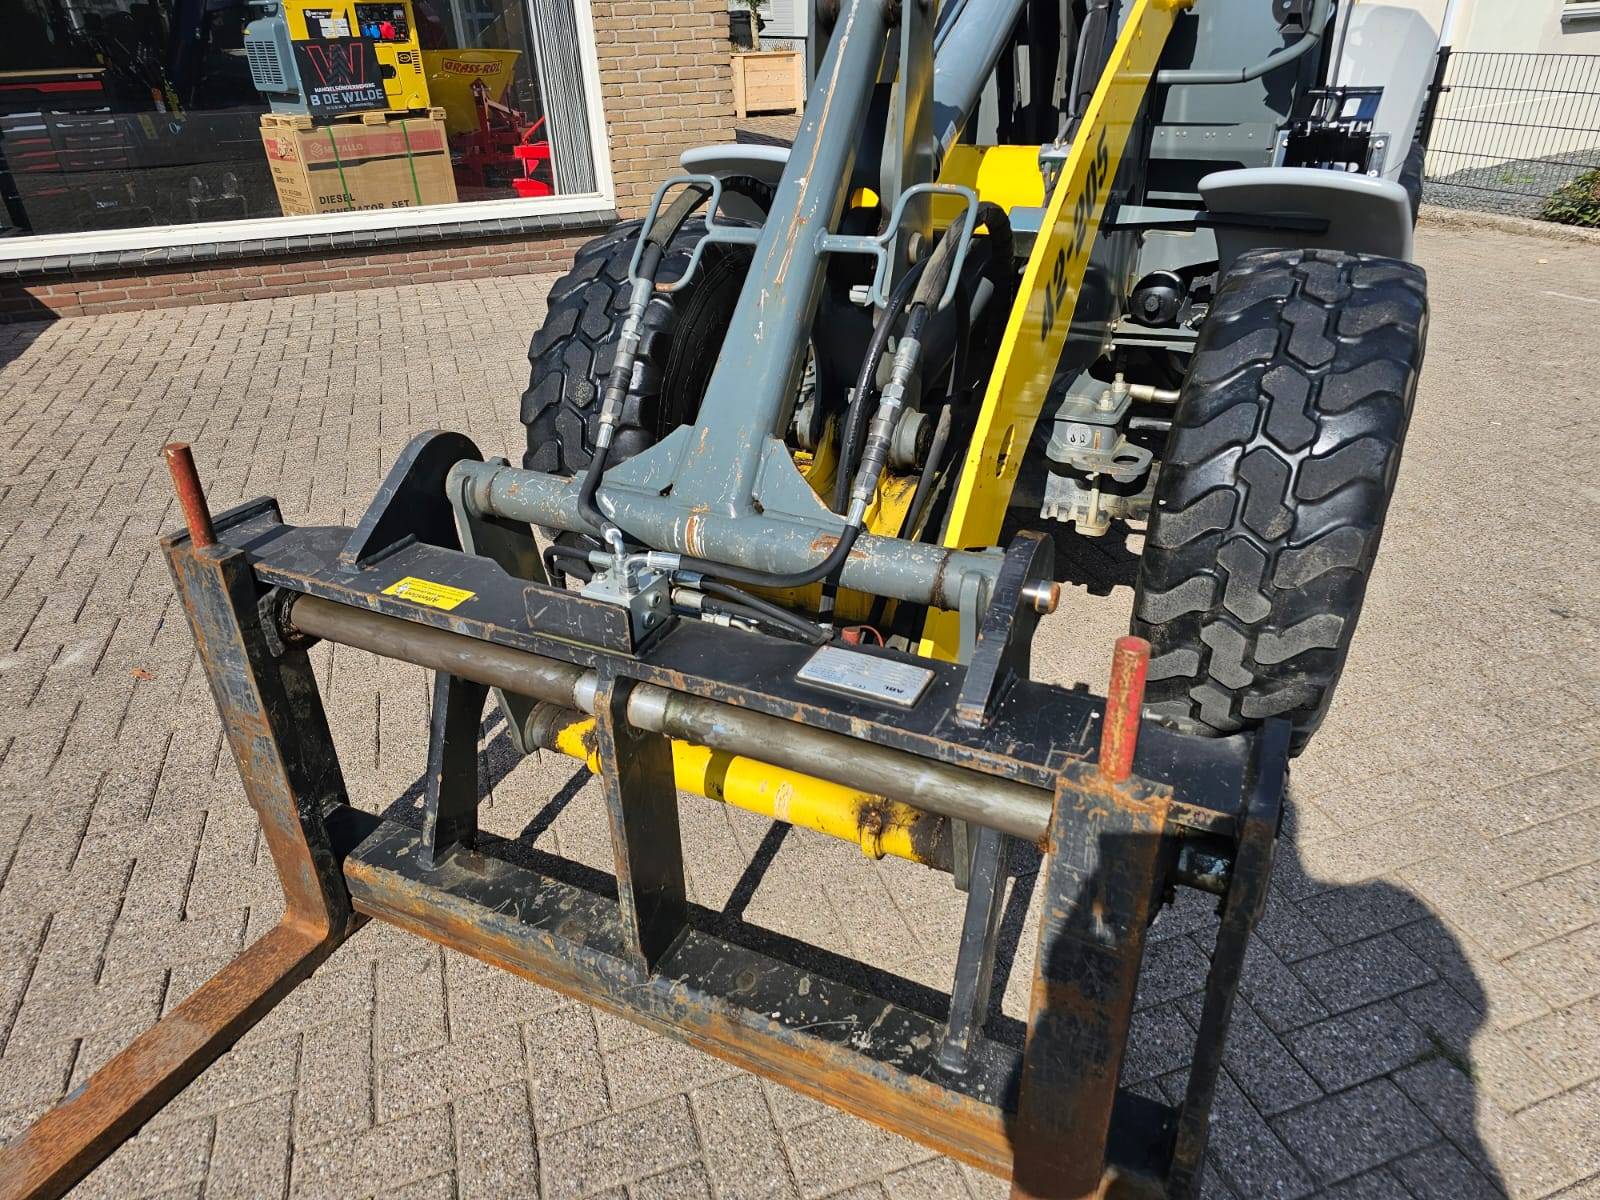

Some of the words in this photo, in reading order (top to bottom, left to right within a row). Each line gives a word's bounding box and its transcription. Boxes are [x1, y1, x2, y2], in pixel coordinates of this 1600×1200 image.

[310, 94, 321, 106] B
[323, 93, 341, 105] DE
[342, 89, 384, 104] WILDE
[319, 193, 356, 205] DIESEL
[391, 199, 410, 208] SET
